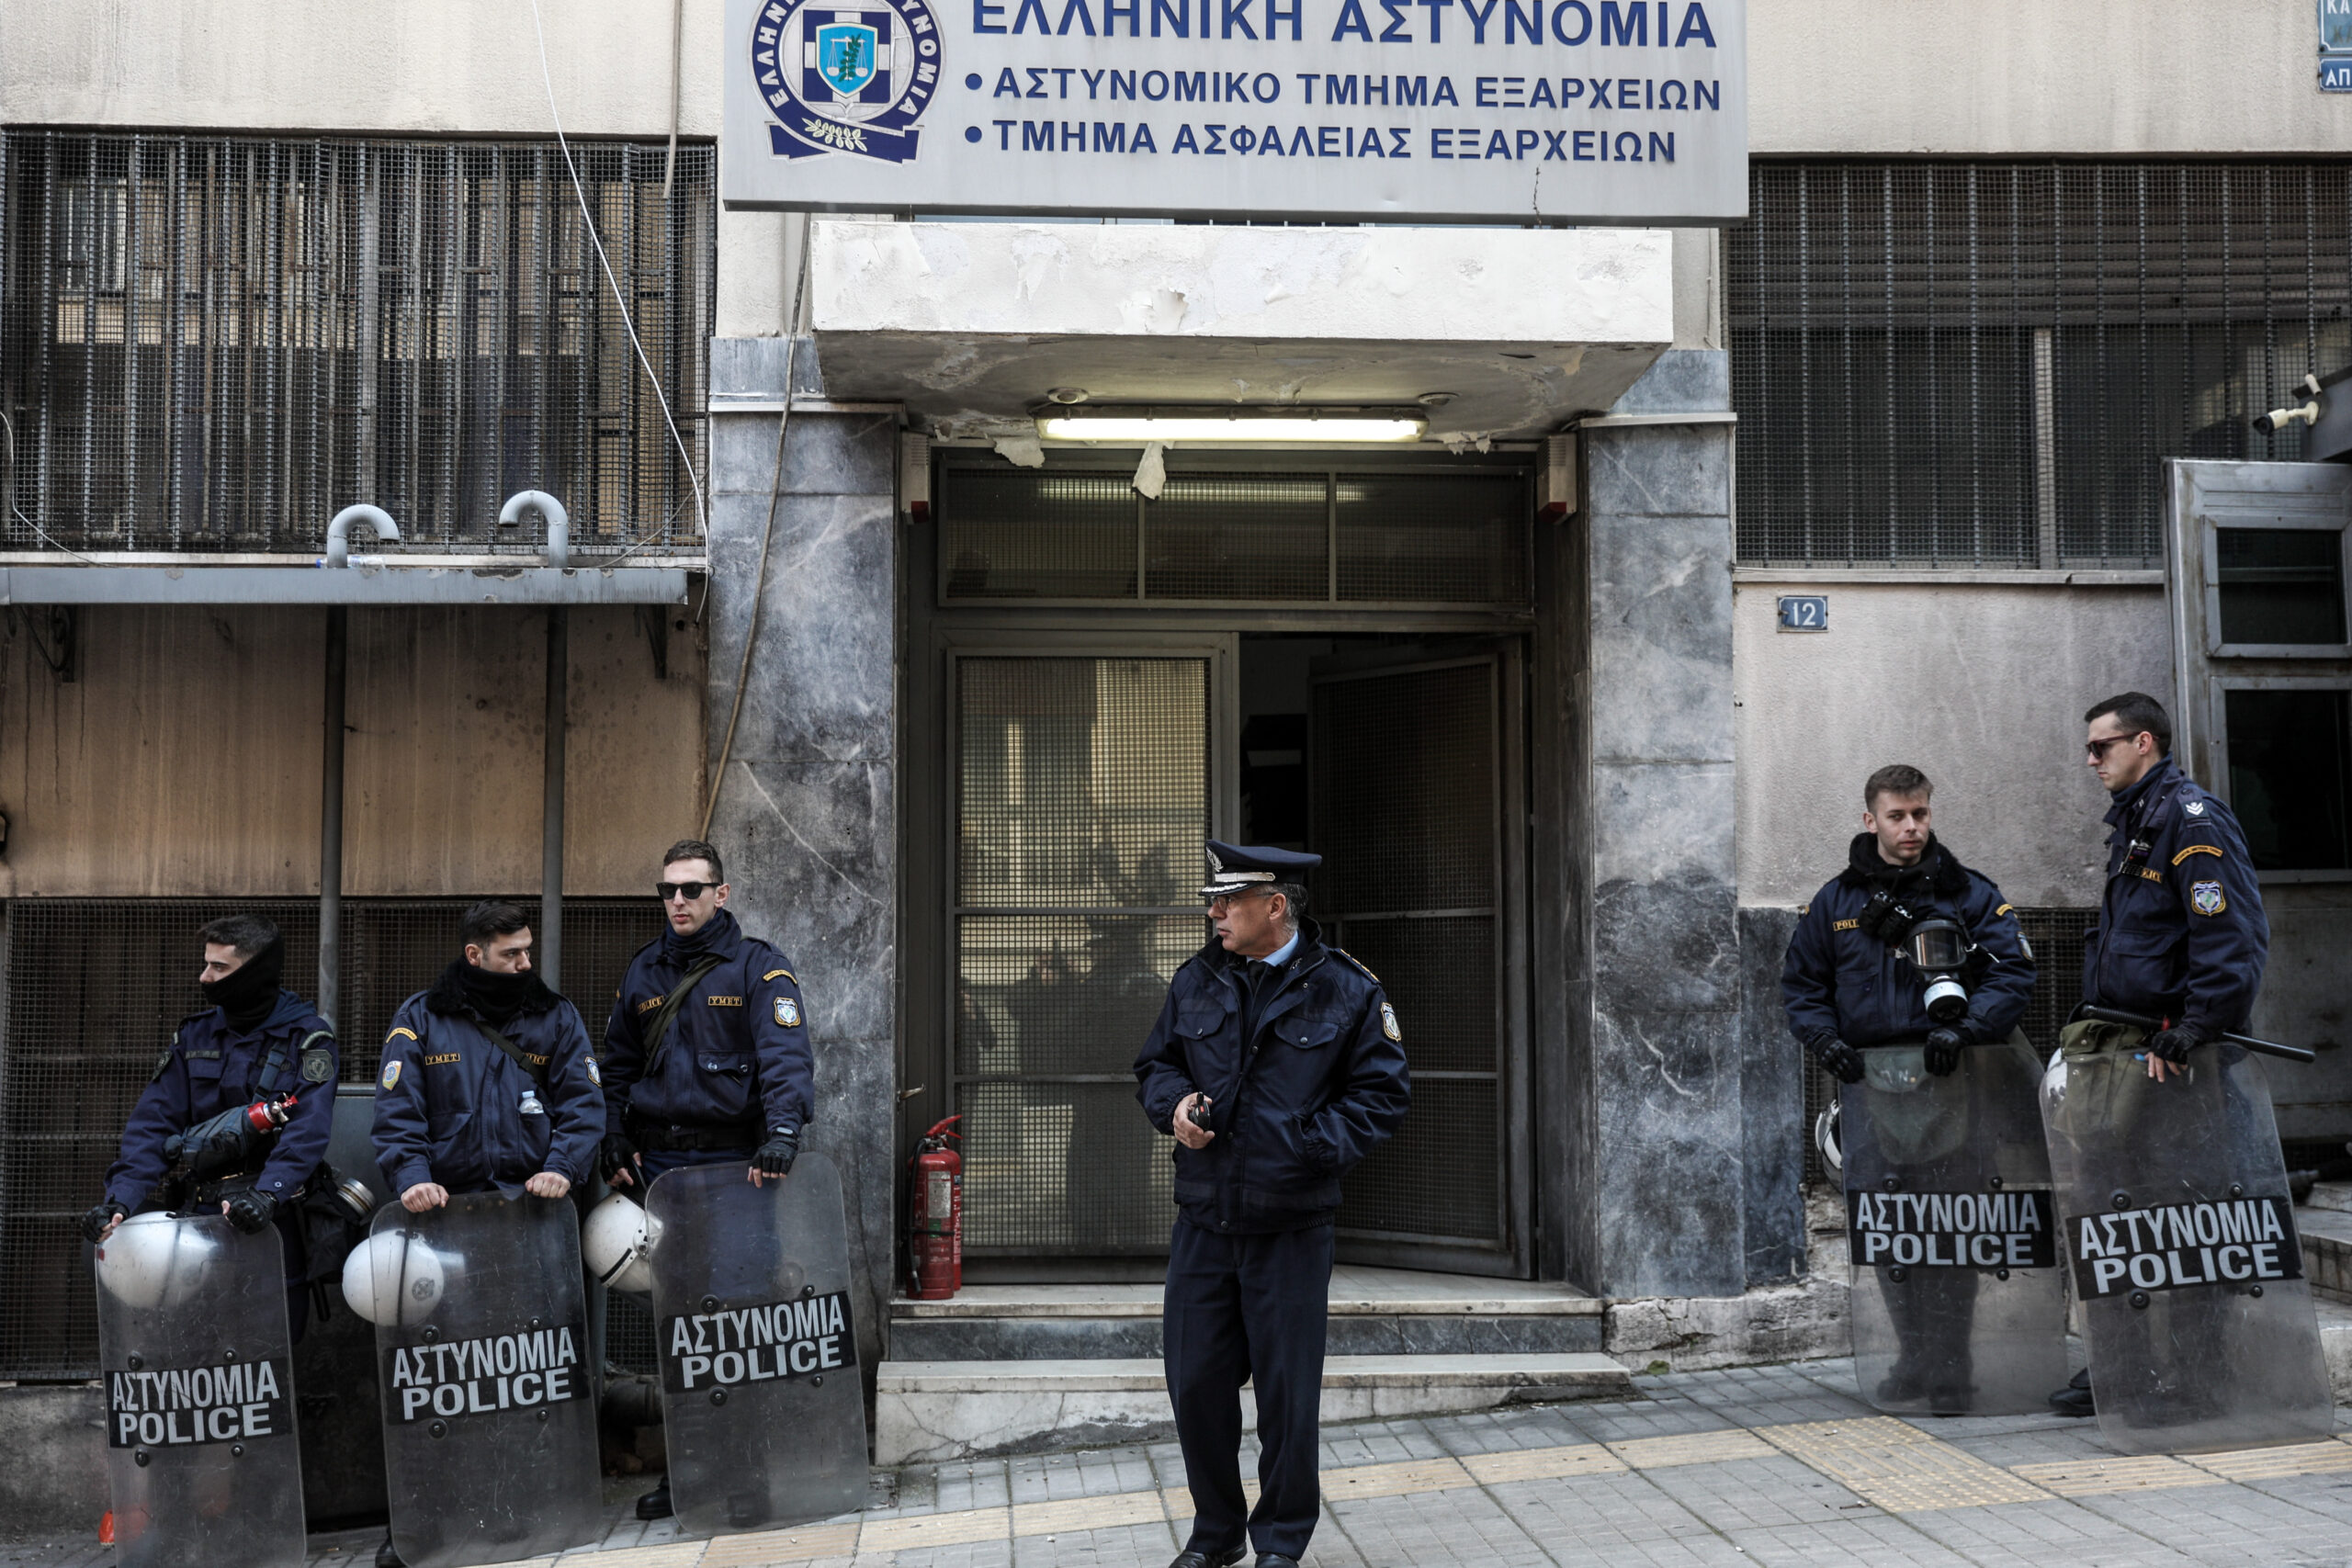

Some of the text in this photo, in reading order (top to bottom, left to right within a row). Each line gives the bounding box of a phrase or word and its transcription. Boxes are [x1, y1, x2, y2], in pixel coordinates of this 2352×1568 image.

[973, 0, 1717, 48] ΕΛΛΗΝΙΚΗ ΑΣΤΥΝΟΜΙΑ
[993, 67, 1720, 110] ΑΣΤΥΝΟΜΙΚΟ ΤΜΗΜΑ ΕΞΑΡΧΕΙΩΝ
[993, 120, 1675, 163] ΤΜΗΜΑ ΑΣΦΑΛΕΙΑΣ ΕΞΑΡΧΕΙΩΝ
[1793, 602, 1815, 626] 12
[1856, 1192, 2041, 1233] ΑΣΤΥΝΟΜΙΑ
[2081, 1199, 2285, 1259] ΑΣΤΥΝΟΜΙΑ
[1865, 1232, 2034, 1265] POLICE
[2093, 1243, 2283, 1293] POLICE
[672, 1294, 845, 1356] ΑΣΤΥΝΟΜΙΑ
[392, 1326, 577, 1388] ΑΣΤΥΝΟΜΙΑ
[682, 1335, 842, 1389] POLICE
[113, 1360, 279, 1411] ΑΣΤΥΝΟΜΙΑ
[402, 1367, 571, 1420] POLICE
[119, 1402, 272, 1444] POLICE
